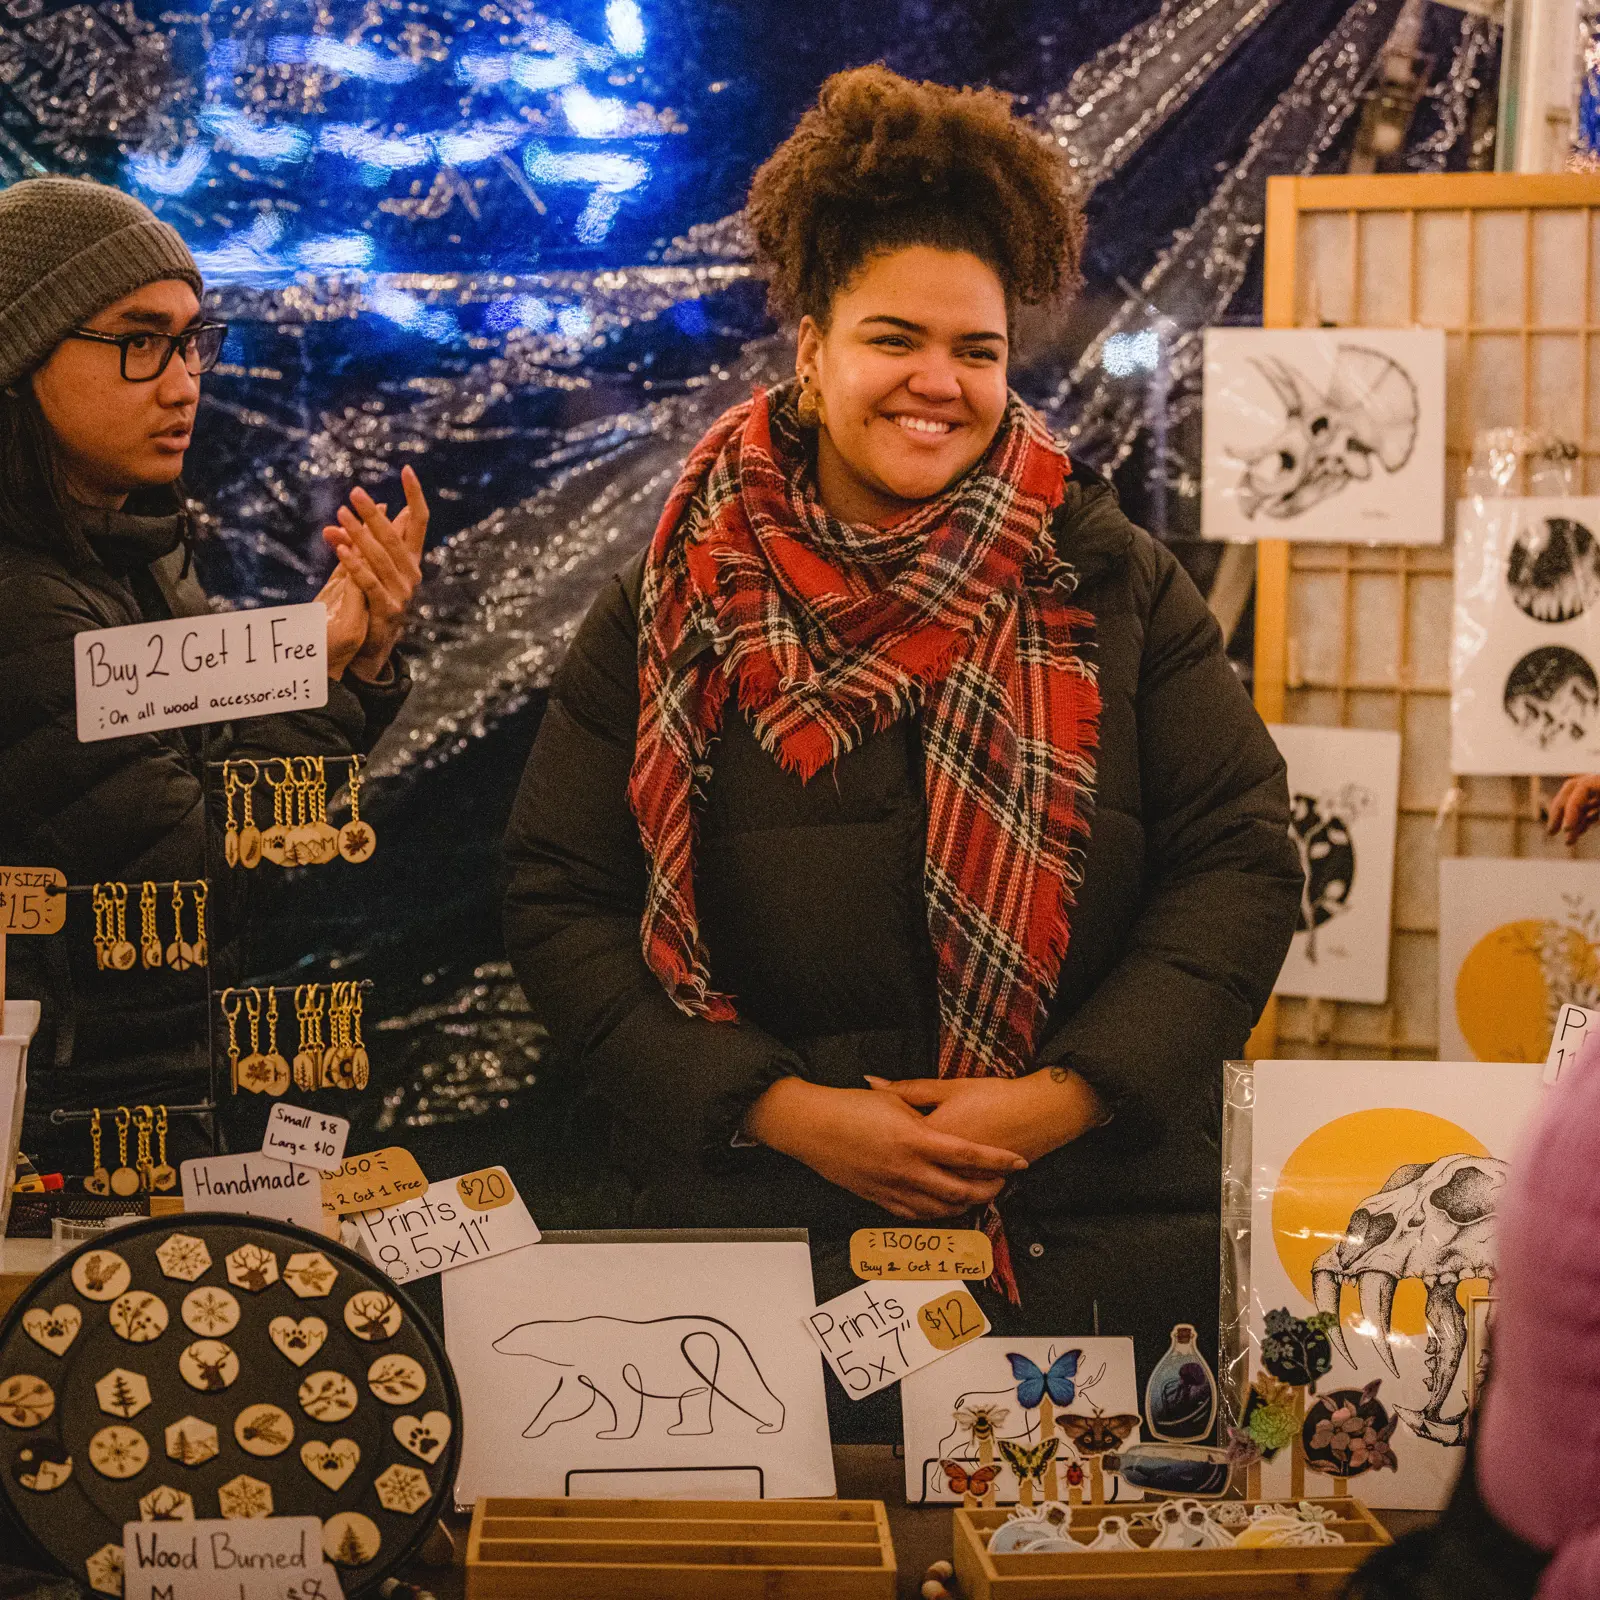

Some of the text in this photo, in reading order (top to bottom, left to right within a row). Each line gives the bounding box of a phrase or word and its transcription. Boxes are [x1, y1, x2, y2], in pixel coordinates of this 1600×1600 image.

[87, 617, 317, 695] Buy 2 Get 1 Free
[109, 680, 297, 725] On all wood accessories!
[276, 1108, 338, 1135] Small $8
[269, 1132, 335, 1157] Large $10
[193, 1161, 310, 1196] Handmade
[460, 1173, 506, 1205] $20
[321, 1180, 422, 1211] uy 2 Get 1 Free
[360, 1195, 457, 1242] Prints
[883, 1231, 941, 1251] BOGO
[860, 1261, 882, 1276] Buy
[908, 1260, 931, 1272] Get
[938, 1260, 948, 1273] 1
[809, 1290, 981, 1353] Prints $12
[135, 1530, 307, 1570] Wood Burned
